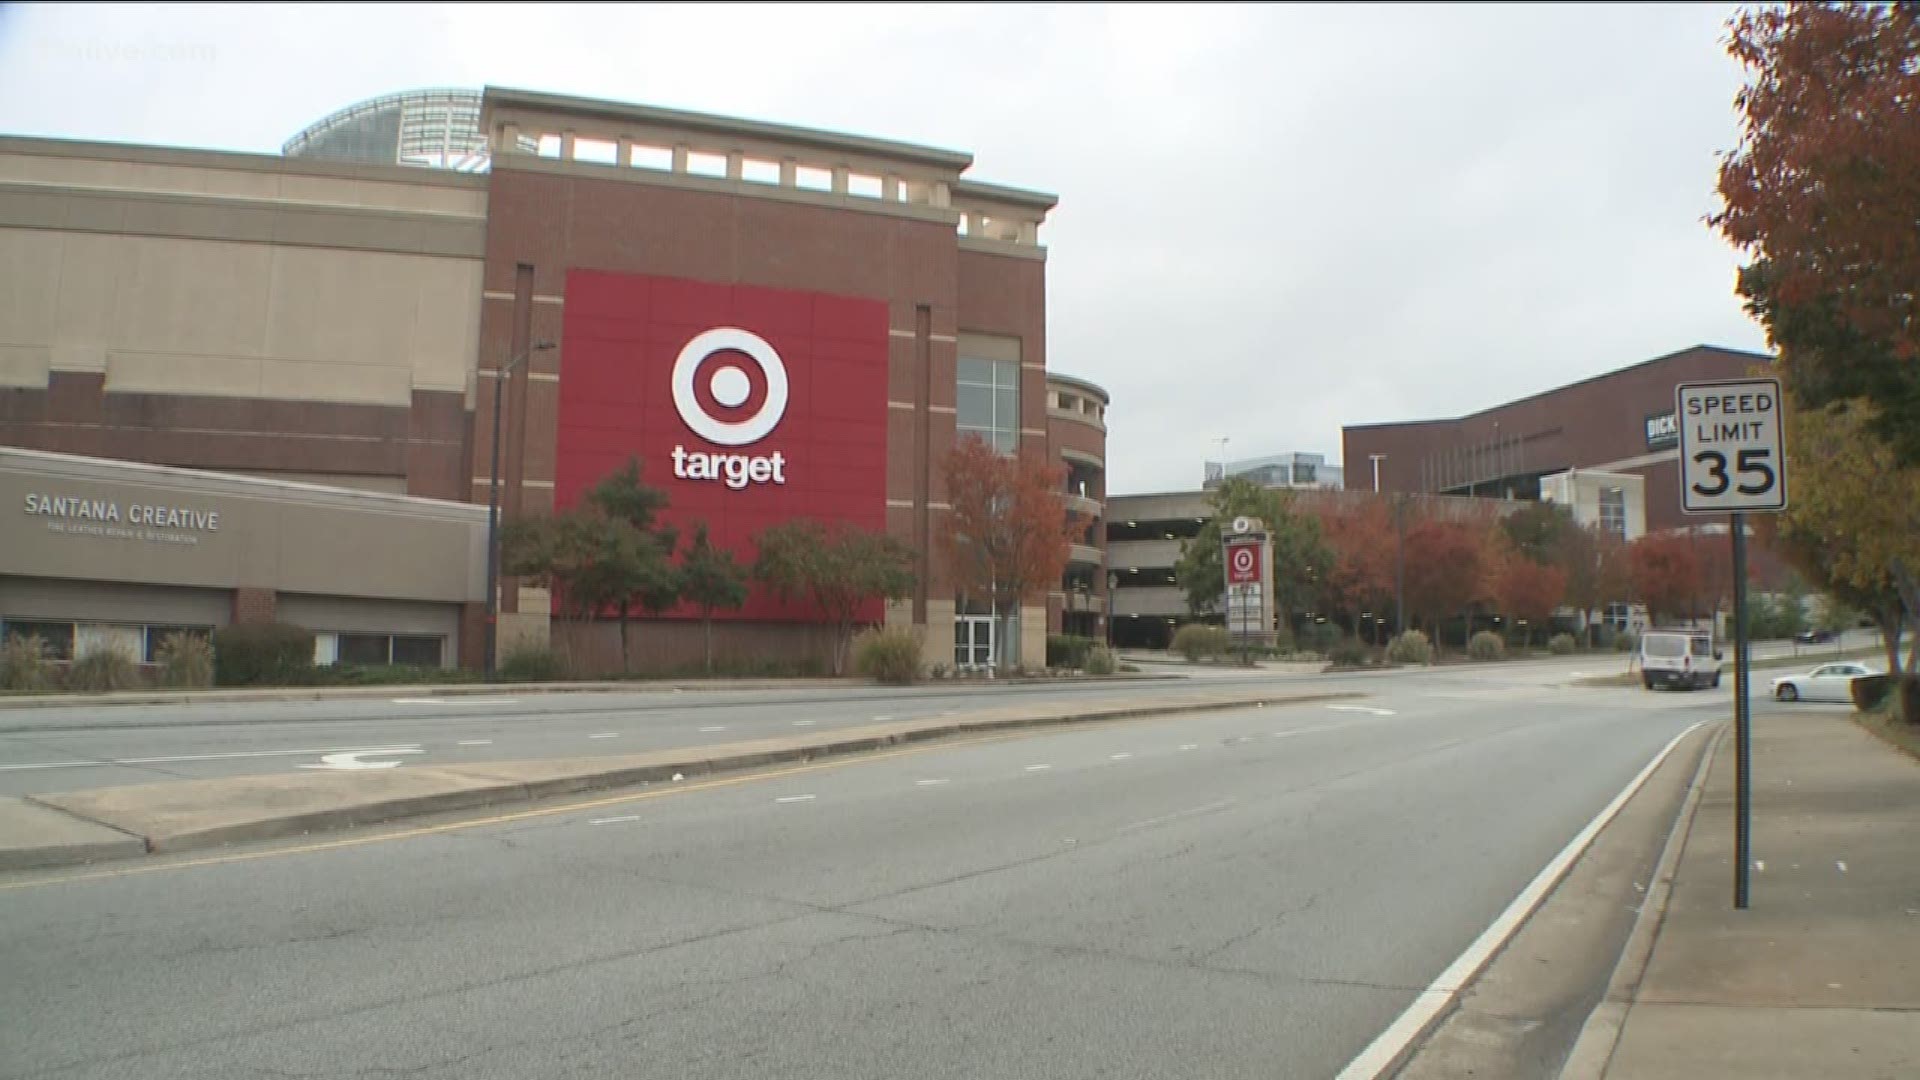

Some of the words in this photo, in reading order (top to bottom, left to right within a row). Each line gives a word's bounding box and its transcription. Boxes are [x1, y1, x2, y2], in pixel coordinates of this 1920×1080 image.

[1687, 395, 1772, 415] SPEED
[1698, 421, 1763, 443] LIMIT
[671, 444, 785, 489] target
[1692, 449, 1775, 496] 35
[24, 493, 120, 521] SANTANA
[129, 504, 219, 530] CREATIVE
